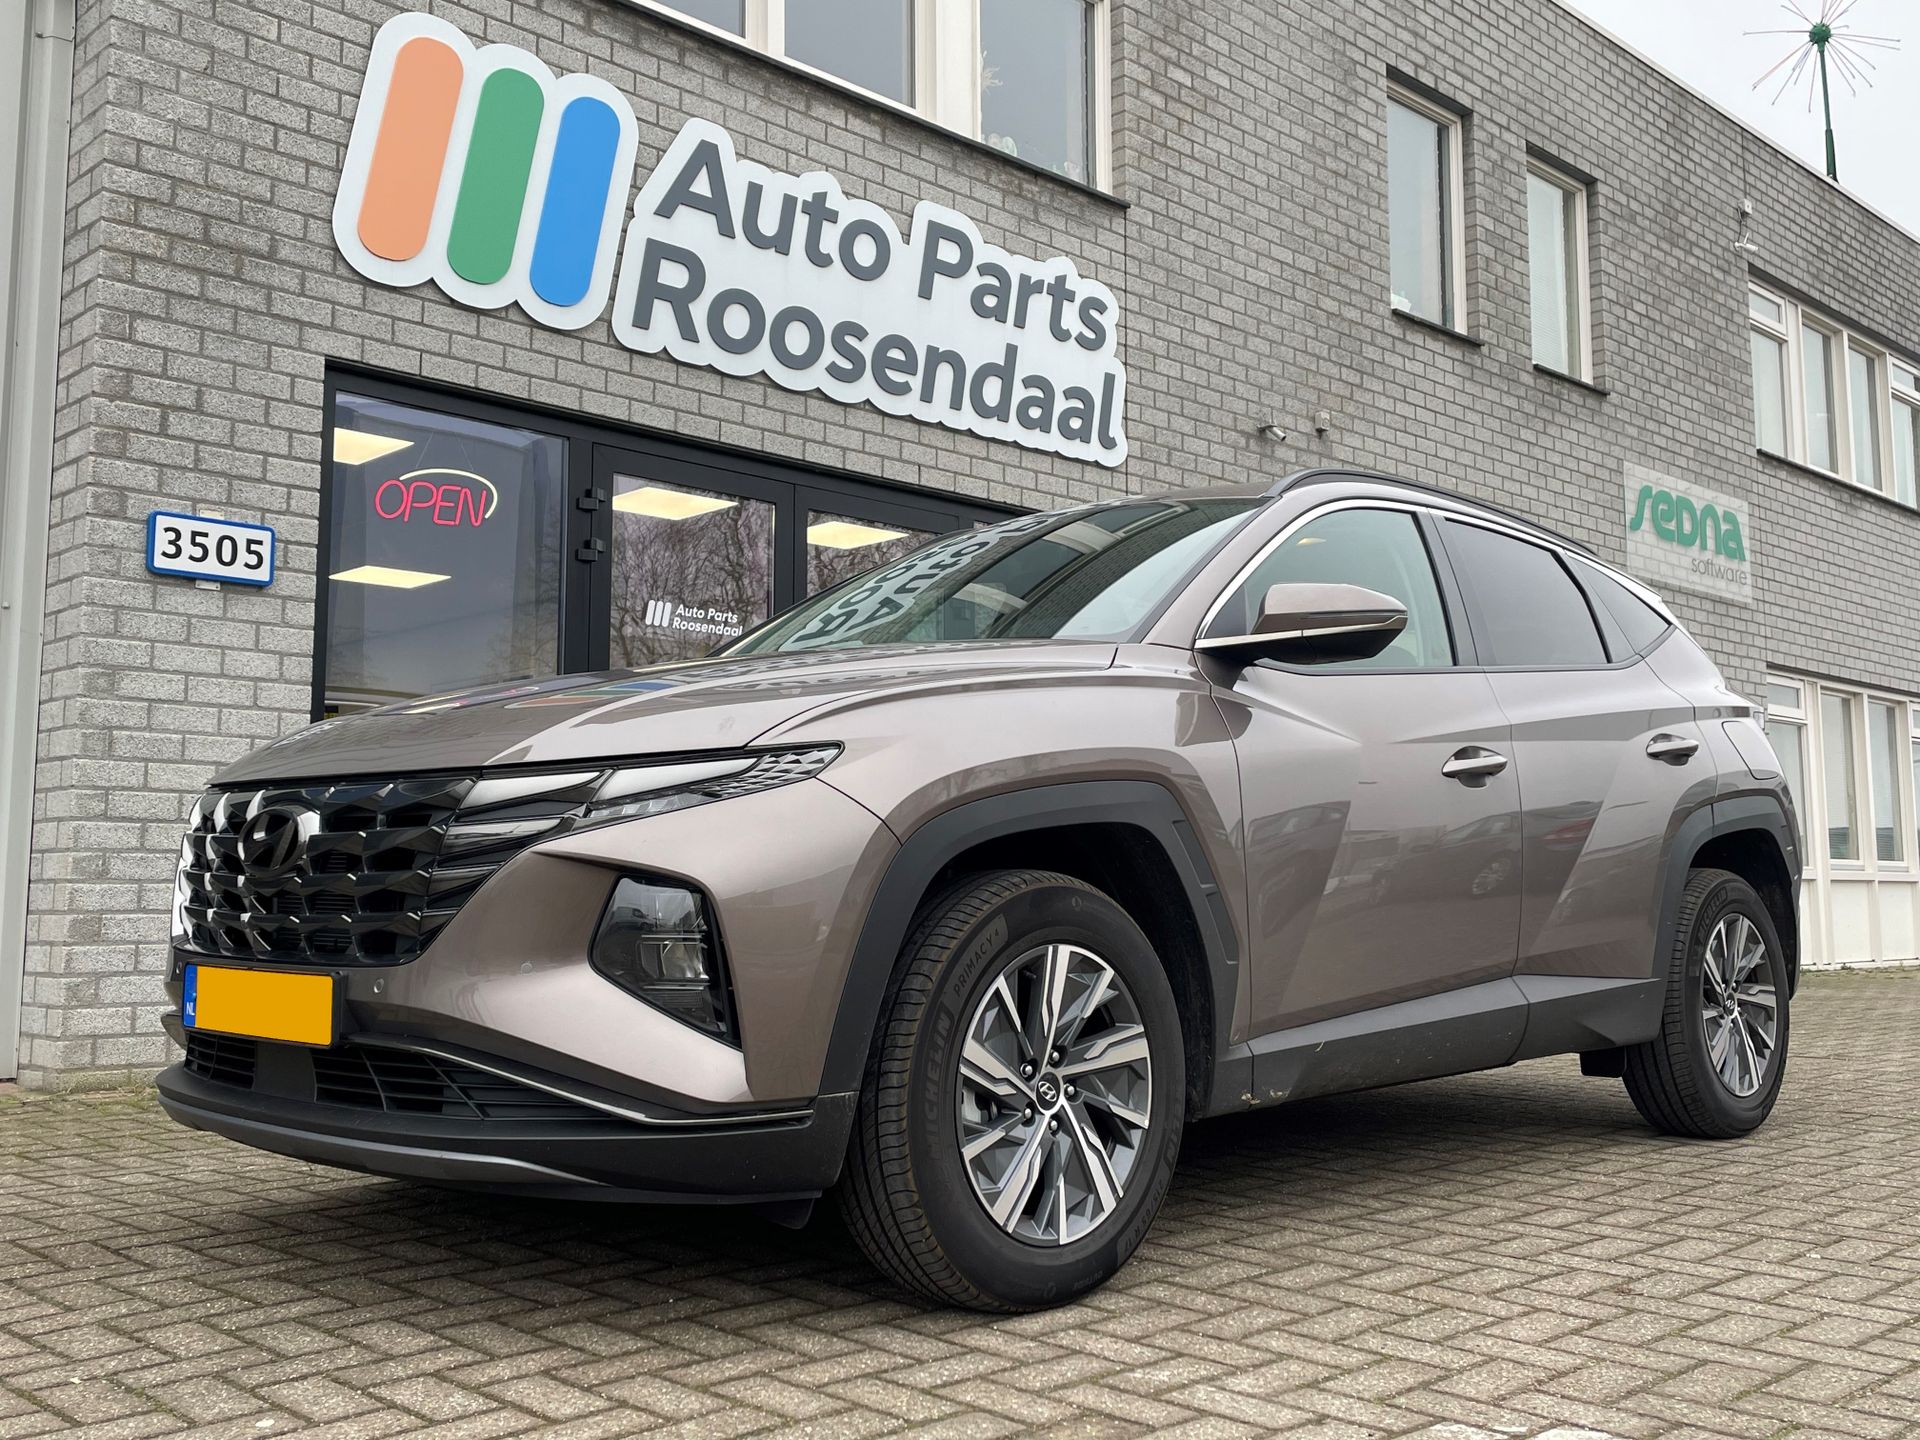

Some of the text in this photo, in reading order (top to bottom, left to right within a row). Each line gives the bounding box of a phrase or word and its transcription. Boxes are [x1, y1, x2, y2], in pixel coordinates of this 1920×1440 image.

[653, 139, 1108, 351] Auto Parts
[632, 237, 1118, 450] Roosendaal
[374, 479, 487, 527] OPEN
[160, 526, 265, 571] 3505
[1691, 557, 1748, 586] software
[672, 617, 743, 637] Roosendaal
[675, 604, 738, 624] Auto Parts
[953, 936, 993, 998] PRIMACY
[186, 1002, 195, 1016] NL
